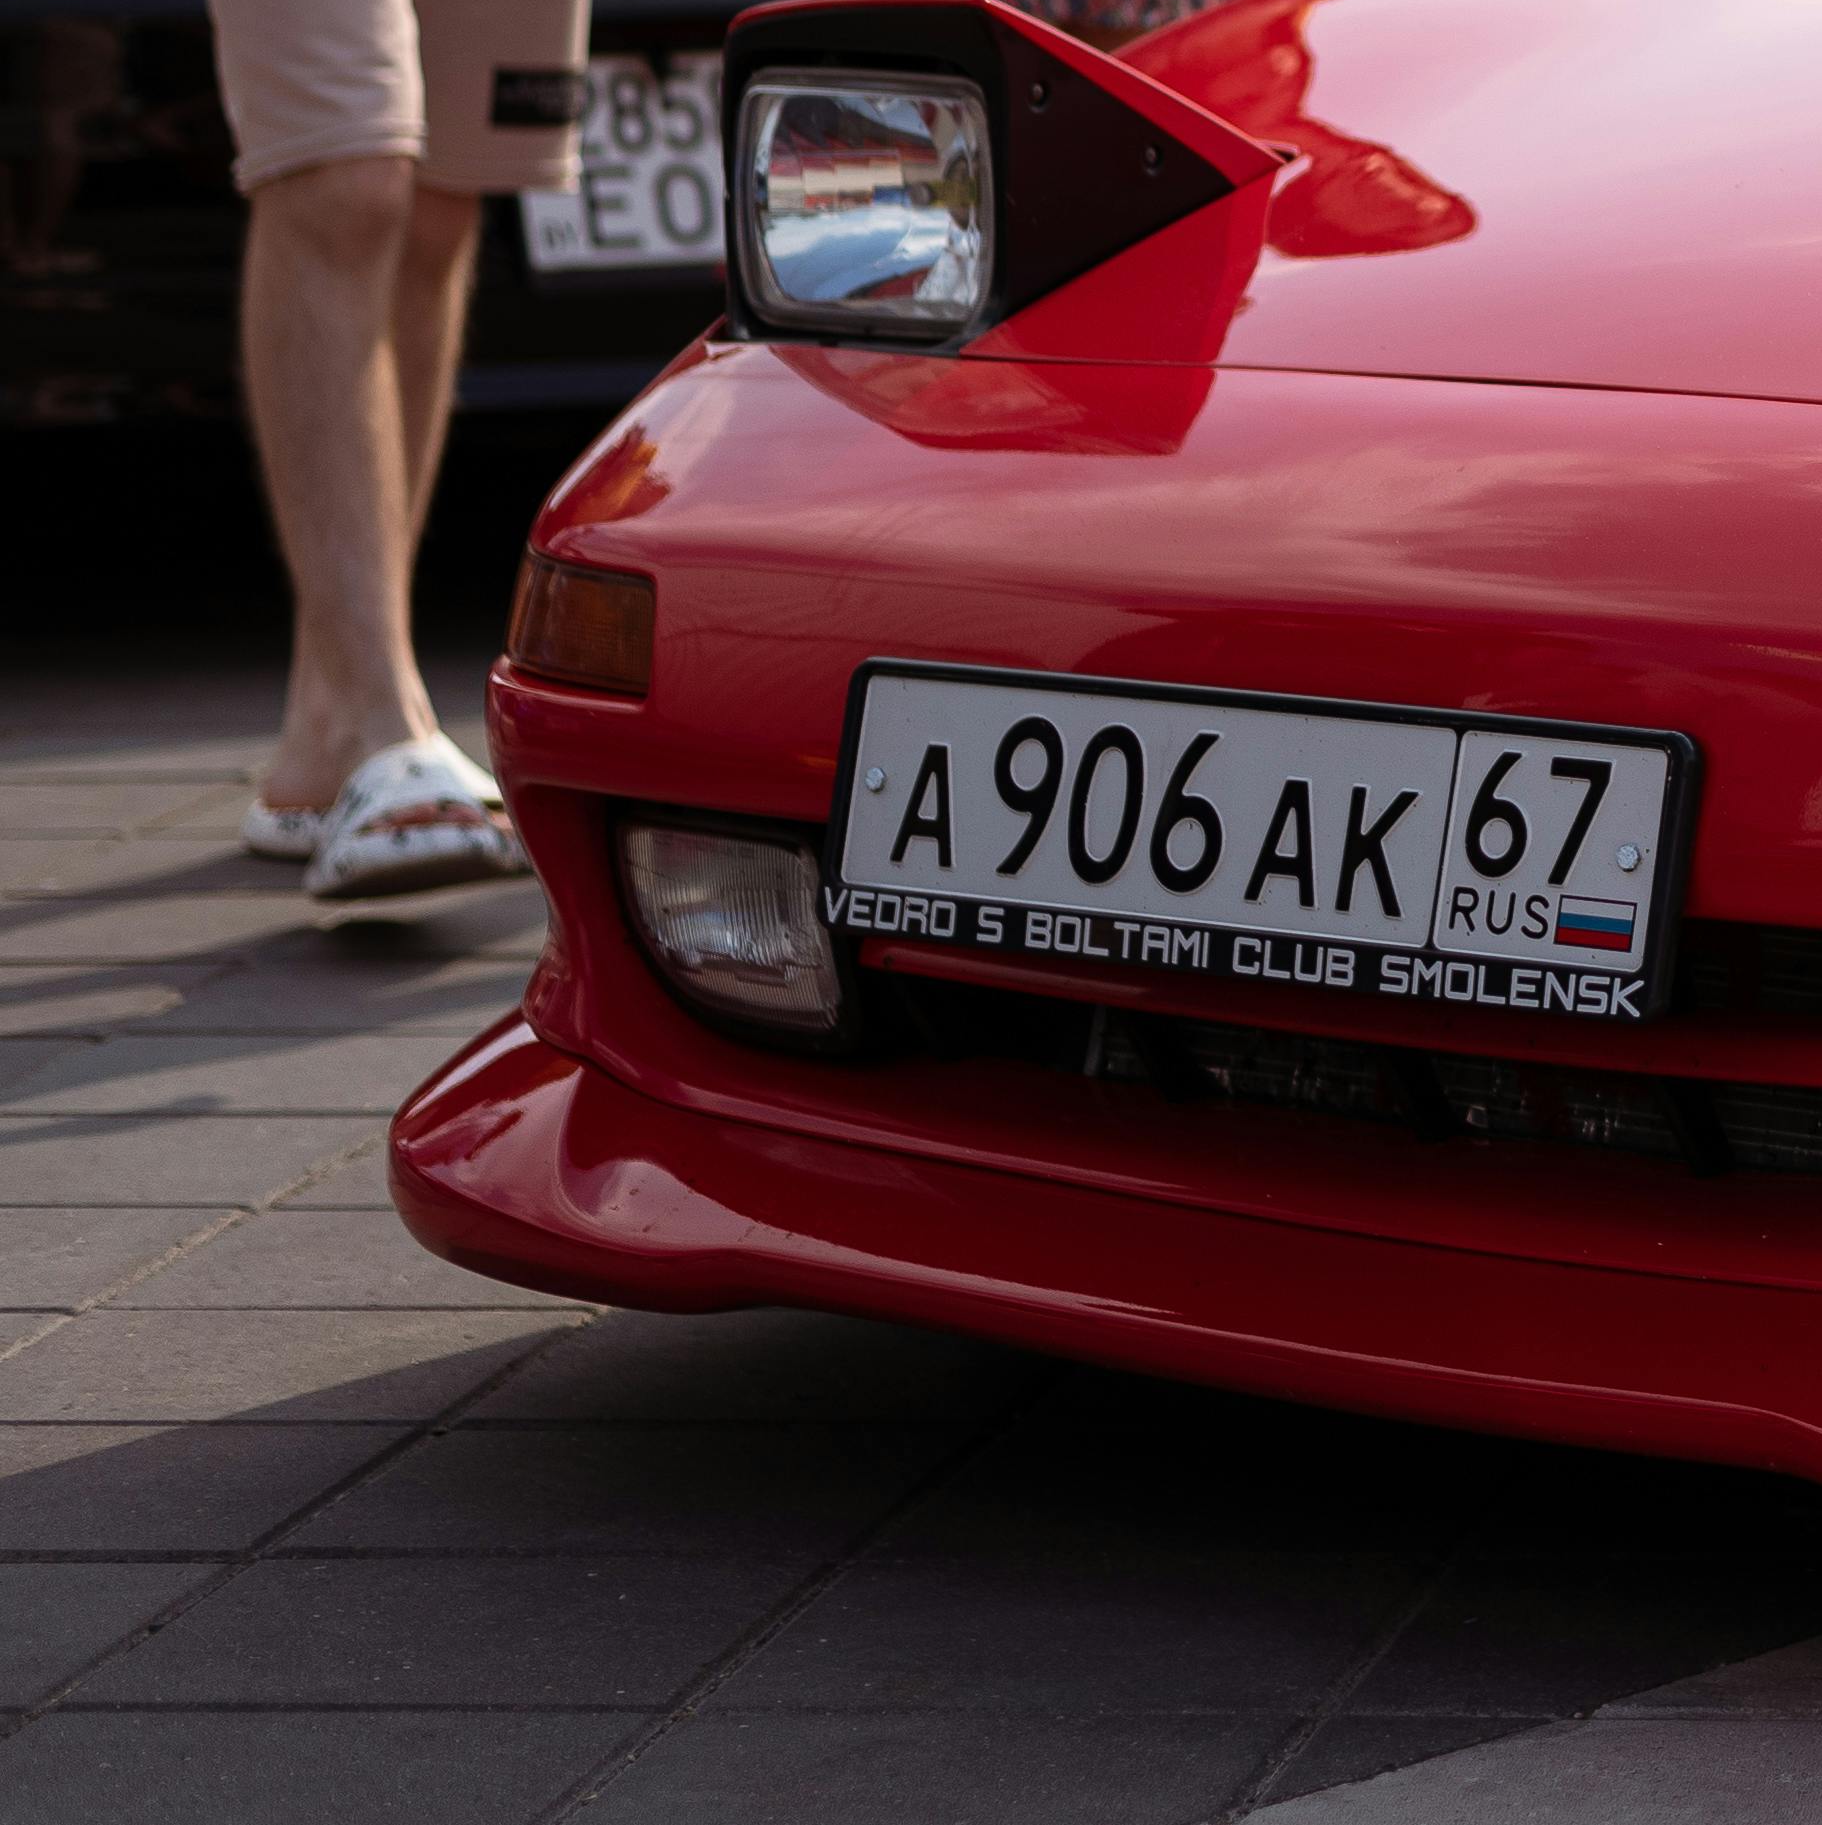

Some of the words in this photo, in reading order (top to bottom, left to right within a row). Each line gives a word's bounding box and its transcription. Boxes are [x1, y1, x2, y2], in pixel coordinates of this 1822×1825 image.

[1465, 751, 1613, 886] 67
[824, 886, 956, 937] VEDRO
[977, 907, 1005, 943] S
[1025, 912, 1210, 968] BOLTAMI
[1232, 937, 1355, 987] CLUB
[1379, 954, 1645, 1018] SMOLENSK
[1448, 887, 1549, 939] RUS
